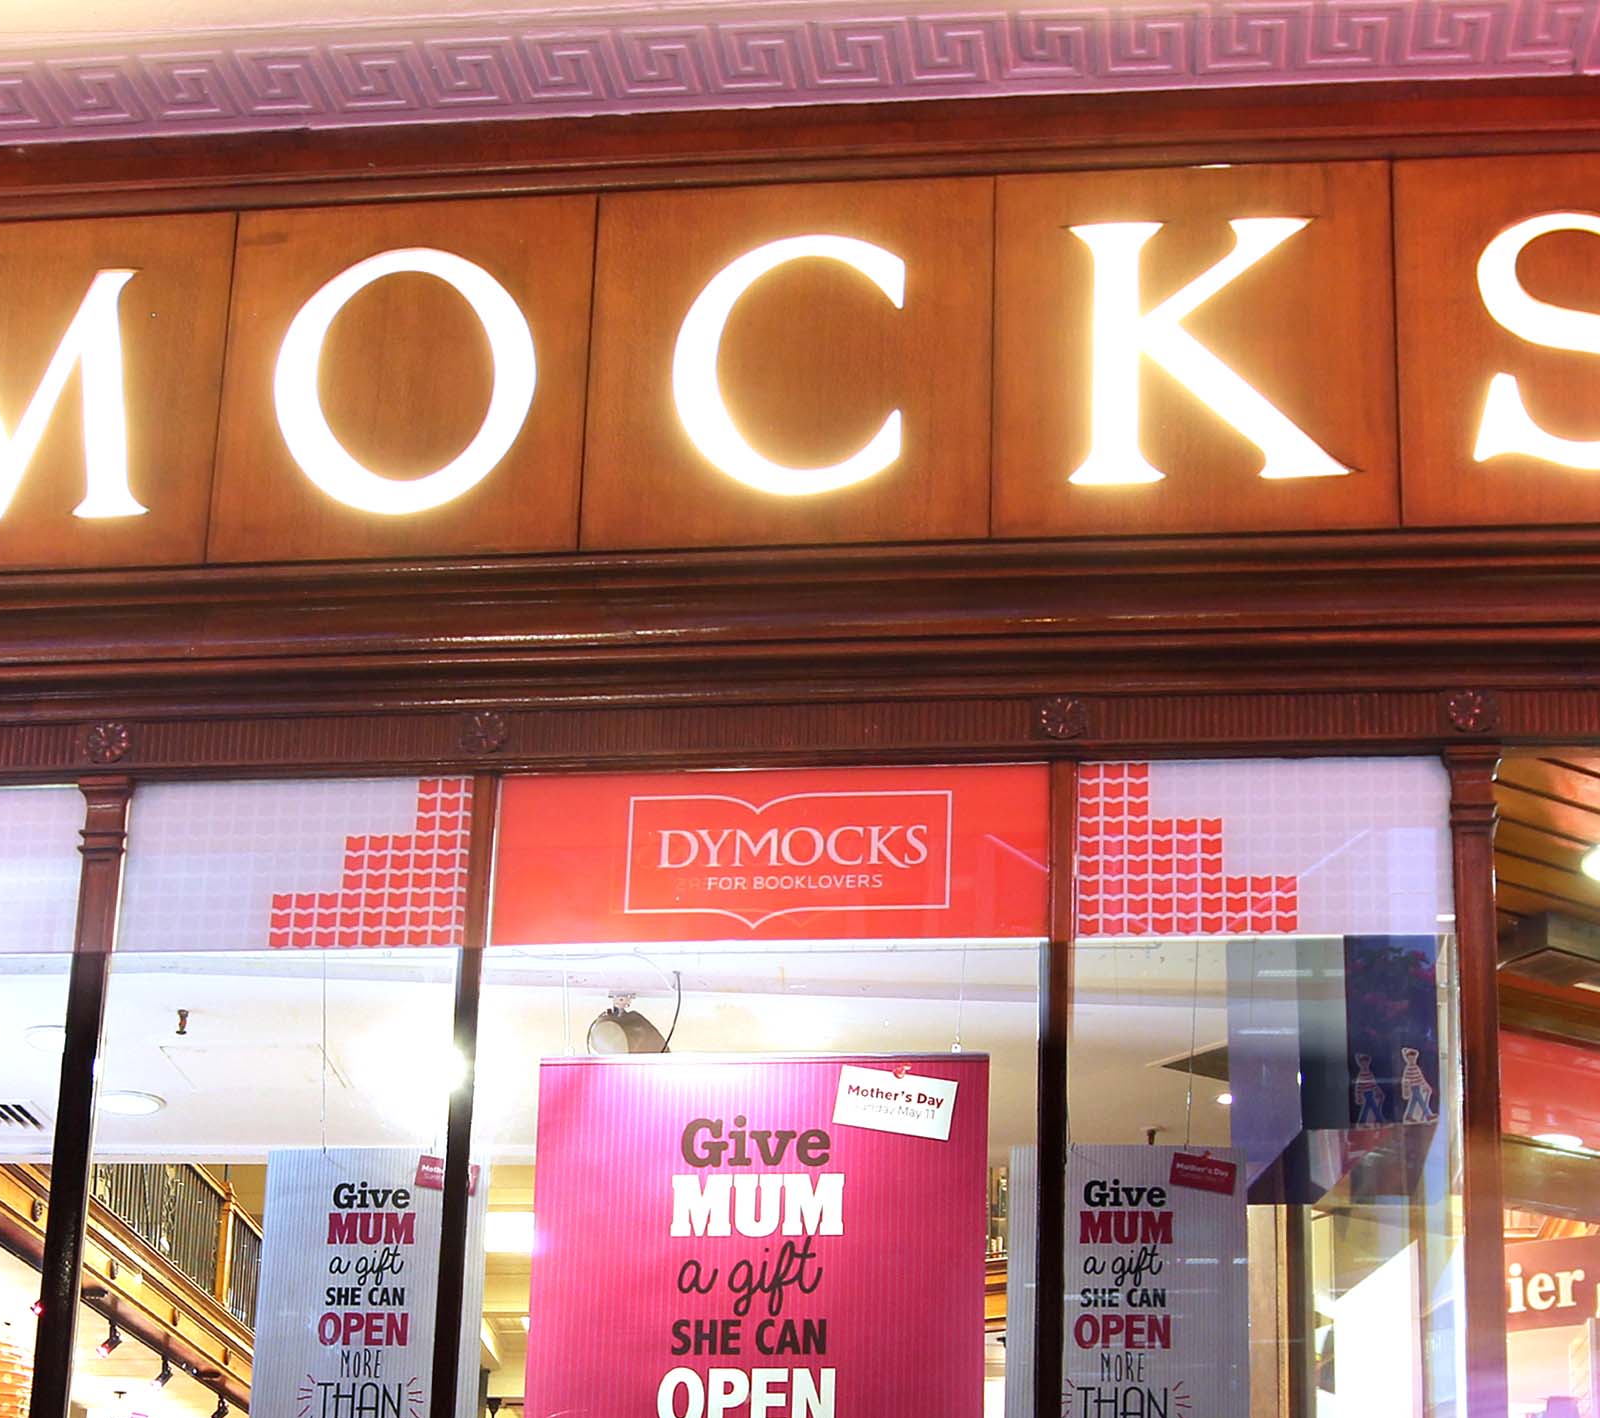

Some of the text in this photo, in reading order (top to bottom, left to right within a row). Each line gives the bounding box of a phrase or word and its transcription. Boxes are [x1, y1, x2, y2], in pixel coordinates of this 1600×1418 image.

[658, 825, 928, 869] DYMOCKS
[707, 874, 883, 890] FOR BOOKLOVERS
[848, 1085, 945, 1109] Mother's Day
[898, 1106, 922, 1120] May
[925, 1109, 936, 1120] 11
[682, 1117, 831, 1168] Give
[333, 1182, 410, 1209] Give
[670, 1174, 844, 1237] MUM
[1083, 1179, 1167, 1208] Give
[327, 1213, 416, 1244] MUM
[1080, 1211, 1173, 1244] MUM
[329, 1245, 404, 1286] a gift
[677, 1236, 824, 1316] a gift
[1083, 1244, 1163, 1287] a gift
[325, 1288, 405, 1306] SHE CAN
[1080, 1288, 1166, 1308] SHE CAN
[1507, 1262, 1584, 1312] ier
[318, 1312, 409, 1346] OPEN
[671, 1319, 827, 1355] SHE CAN
[1074, 1314, 1172, 1350] OPEN
[340, 1349, 381, 1378] MORE
[1100, 1352, 1145, 1382] MORE
